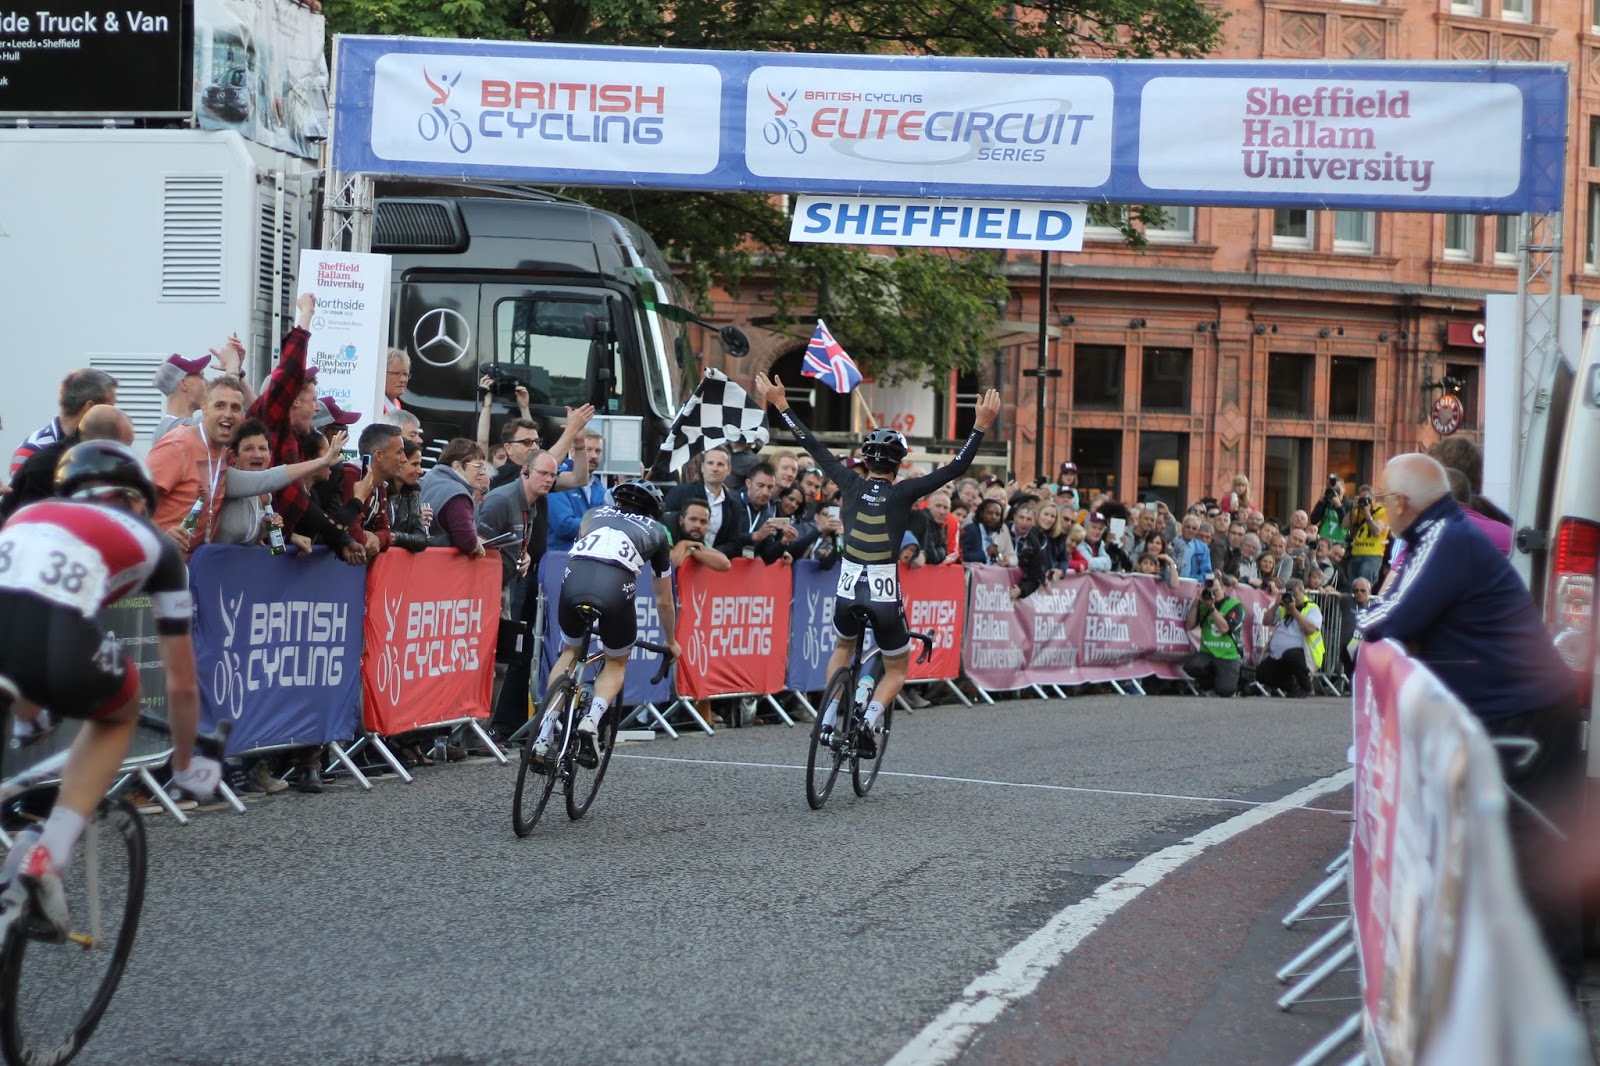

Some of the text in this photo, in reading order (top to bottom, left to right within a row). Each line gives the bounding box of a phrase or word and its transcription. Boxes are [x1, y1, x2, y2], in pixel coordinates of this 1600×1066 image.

[36, 11, 97, 32] Truck
[104, 11, 120, 32] &
[126, 10, 168, 32] Van
[12, 40, 36, 48] Leeds
[42, 39, 80, 48] Sheffield
[3, 52, 20, 60] Hull
[481, 80, 665, 113] BRITISH
[804, 91, 922, 103] BRITISH CYCLING
[1246, 87, 1411, 118] Sheffield
[479, 110, 664, 145] CYCLING
[1242, 119, 1376, 149] Hallam
[977, 147, 1046, 162] SERIES
[1241, 150, 1434, 191] University
[803, 202, 1073, 241] SHEFFIELD
[317, 270, 351, 281] Hallam
[318, 261, 360, 273] Sheffield
[317, 279, 365, 292] University
[314, 297, 365, 311] Northside
[311, 357, 357, 371] Strawberry
[316, 351, 335, 360] Blue
[318, 366, 351, 375] Elephant
[1433, 418, 1457, 434] COFFEE
[576, 534, 602, 552] 37
[619, 540, 637, 563] 37
[39, 550, 89, 594] 38
[874, 577, 894, 596] 90
[710, 596, 774, 626] BRITISH
[911, 600, 957, 625] BRITISH
[1088, 589, 1138, 617] Sheffield
[249, 601, 348, 645] BRITISH
[406, 598, 482, 640] BRITISH
[1084, 615, 1130, 642] Hallam
[709, 626, 772, 657] CYCLING
[247, 646, 345, 691] CYCLING
[403, 637, 479, 681] CYCLING
